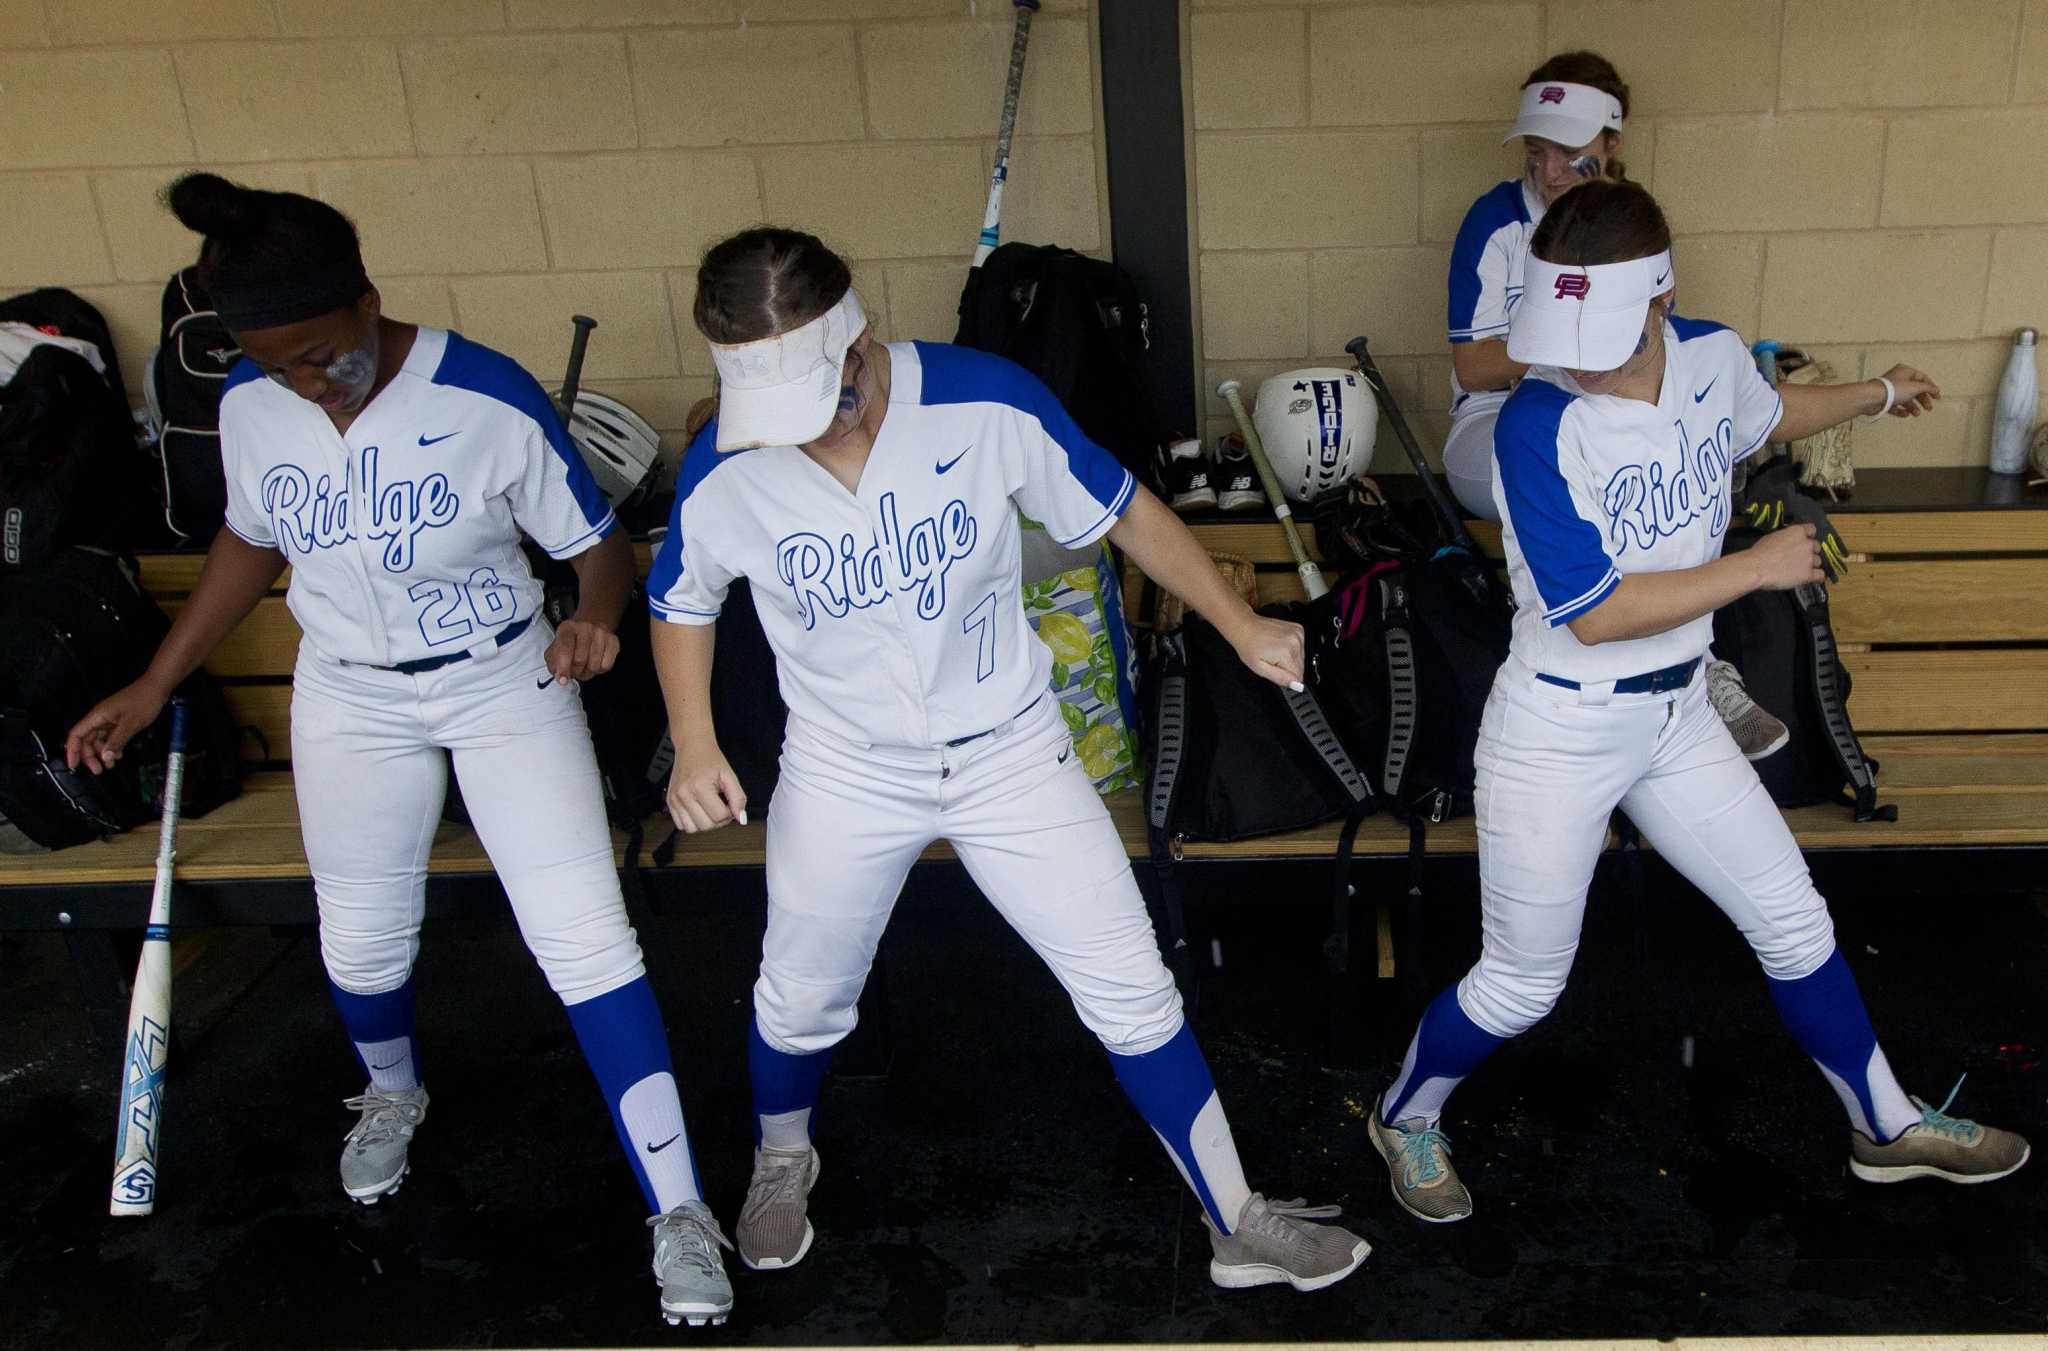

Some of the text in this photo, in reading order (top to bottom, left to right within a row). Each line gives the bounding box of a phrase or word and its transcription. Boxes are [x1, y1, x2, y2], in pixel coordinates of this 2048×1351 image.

[1321, 382, 1337, 462] RIDGE
[262, 446, 459, 573] Ridge
[408, 566, 517, 647] 26
[776, 491, 977, 631] Ridge
[962, 591, 997, 683] 7
